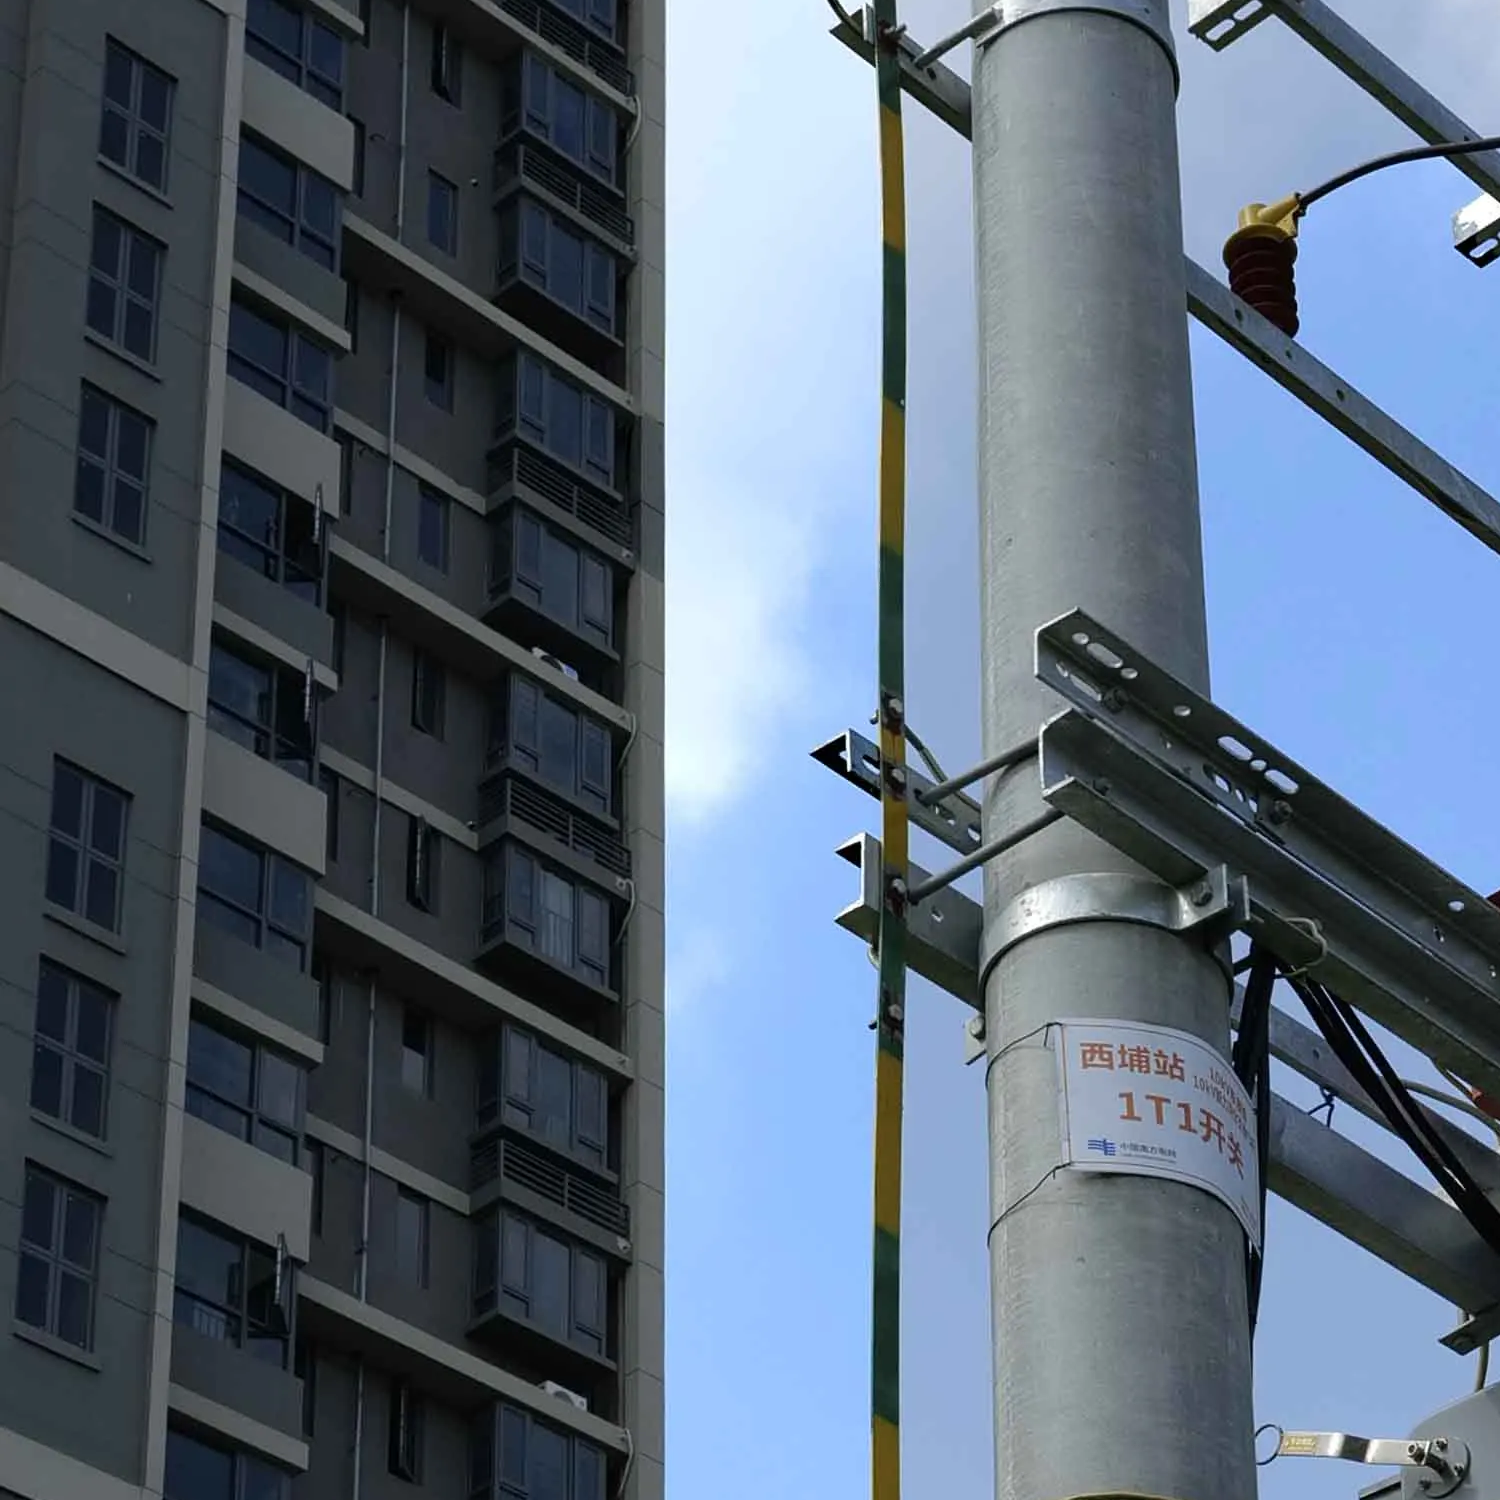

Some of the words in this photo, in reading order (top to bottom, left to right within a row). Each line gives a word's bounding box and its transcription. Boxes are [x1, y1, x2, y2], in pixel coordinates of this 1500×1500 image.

[1080, 1042, 1185, 1082] 西埔站
[1119, 1092, 1244, 1181] 1T1开关
